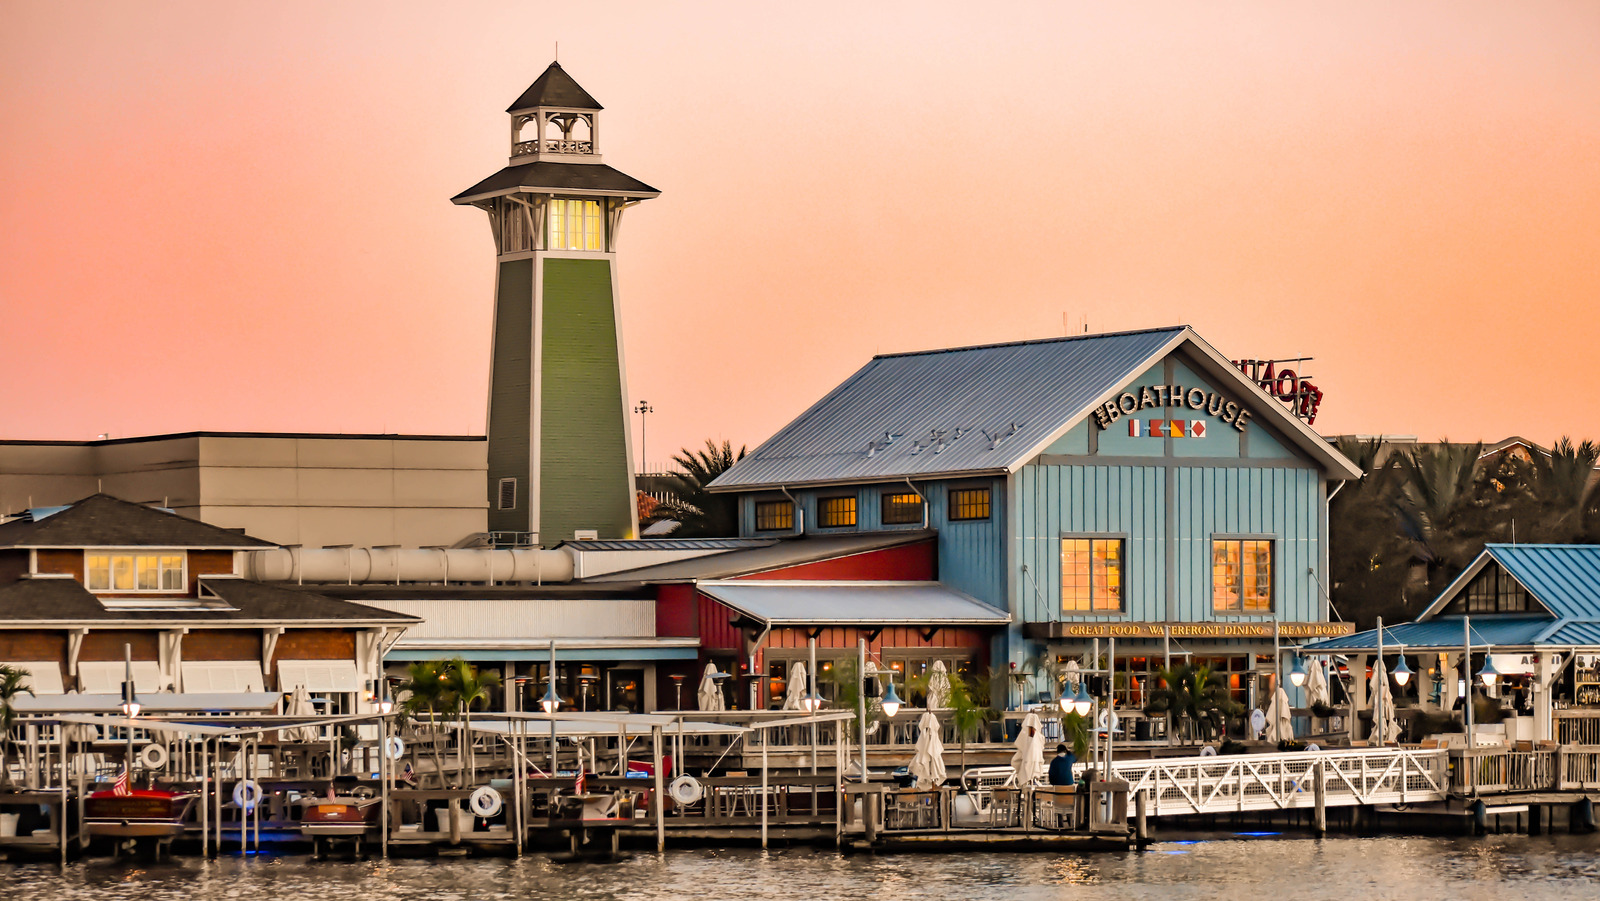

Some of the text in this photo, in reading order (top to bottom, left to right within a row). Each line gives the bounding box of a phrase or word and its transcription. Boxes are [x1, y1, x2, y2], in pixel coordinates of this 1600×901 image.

[1094, 385, 1252, 432] THE BOATHOUSE
[1069, 625, 1105, 635] GREAT
[1109, 625, 1141, 635] FOOD
[1148, 625, 1221, 635] WAERFRONT
[1224, 625, 1264, 635] DINING
[1314, 625, 1349, 635] BOATS
